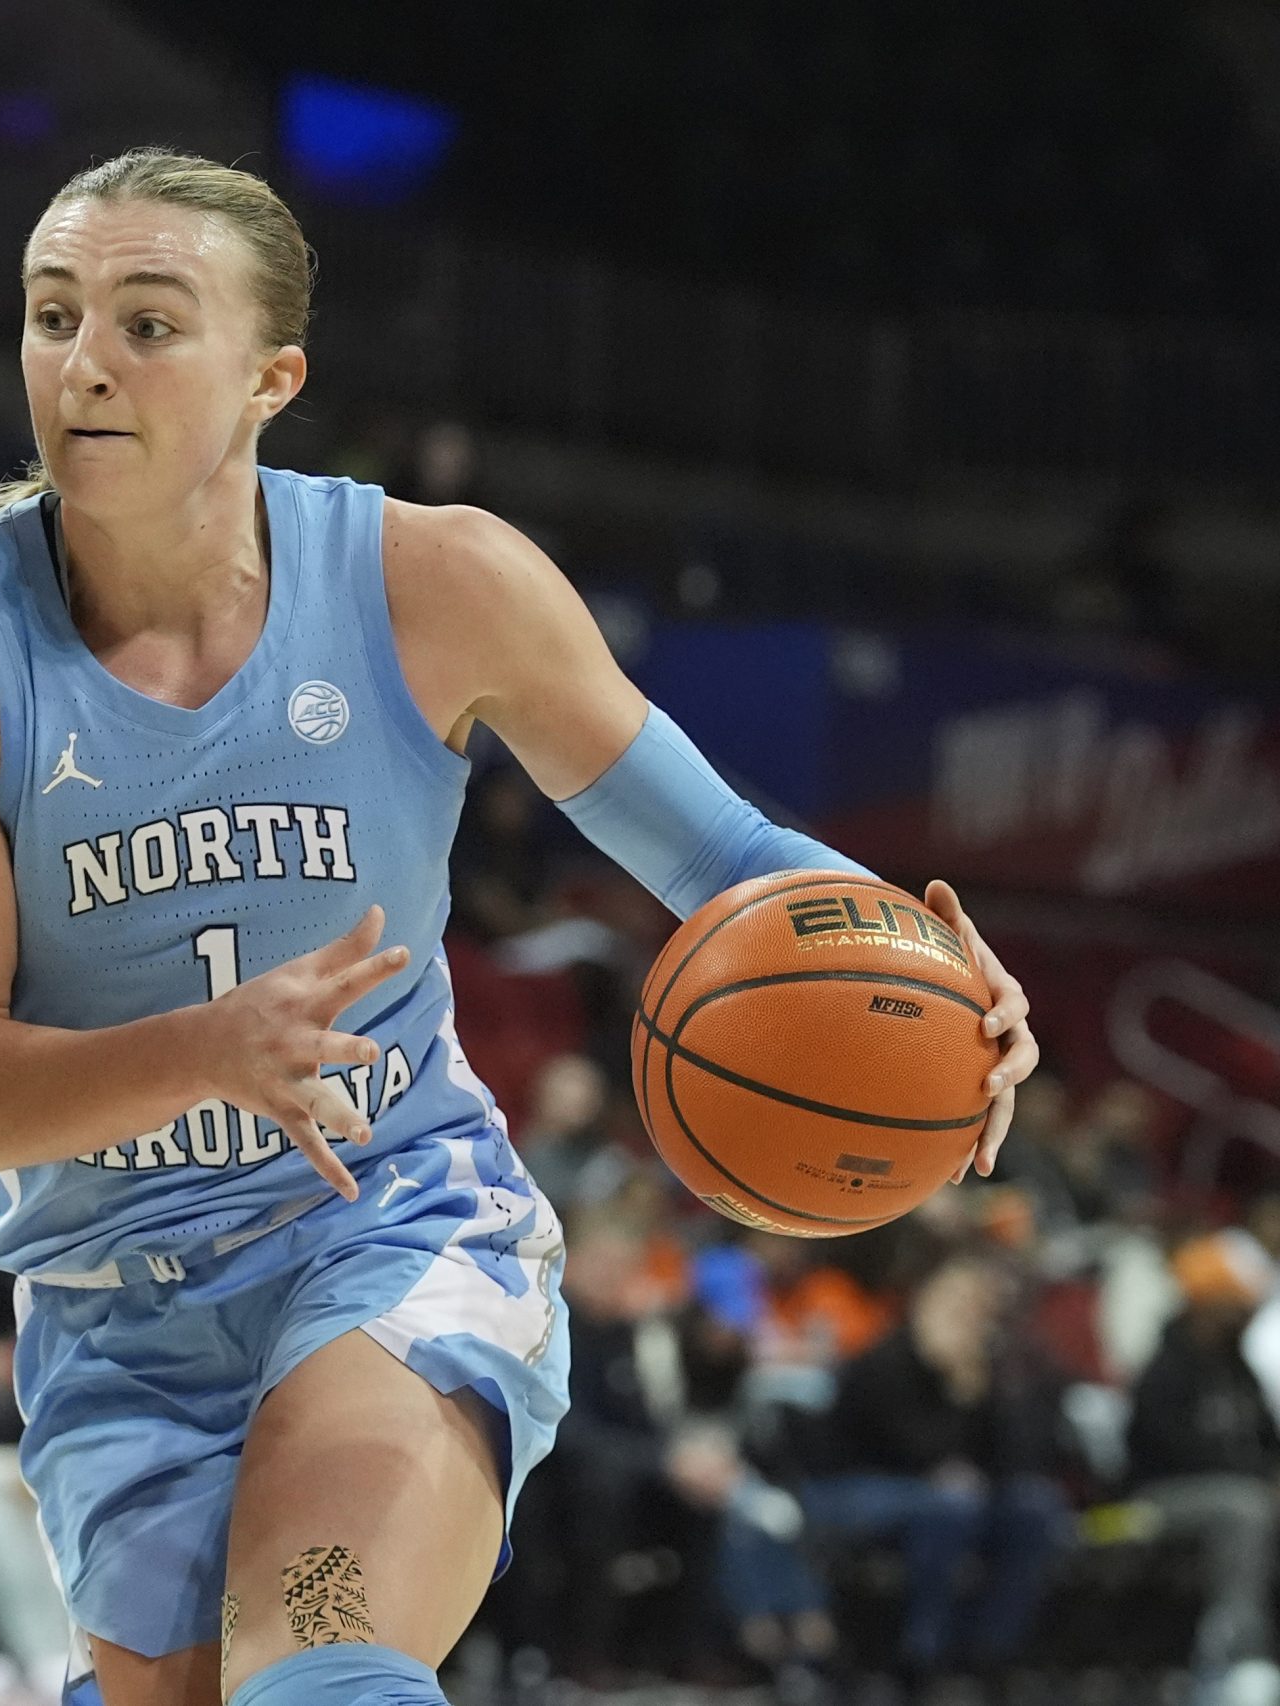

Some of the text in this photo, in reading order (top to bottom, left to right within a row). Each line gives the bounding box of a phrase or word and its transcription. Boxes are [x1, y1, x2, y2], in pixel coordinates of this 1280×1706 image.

[63, 803, 357, 916] NORTH
[193, 923, 241, 1002] 1
[786, 897, 969, 966] ELITE
